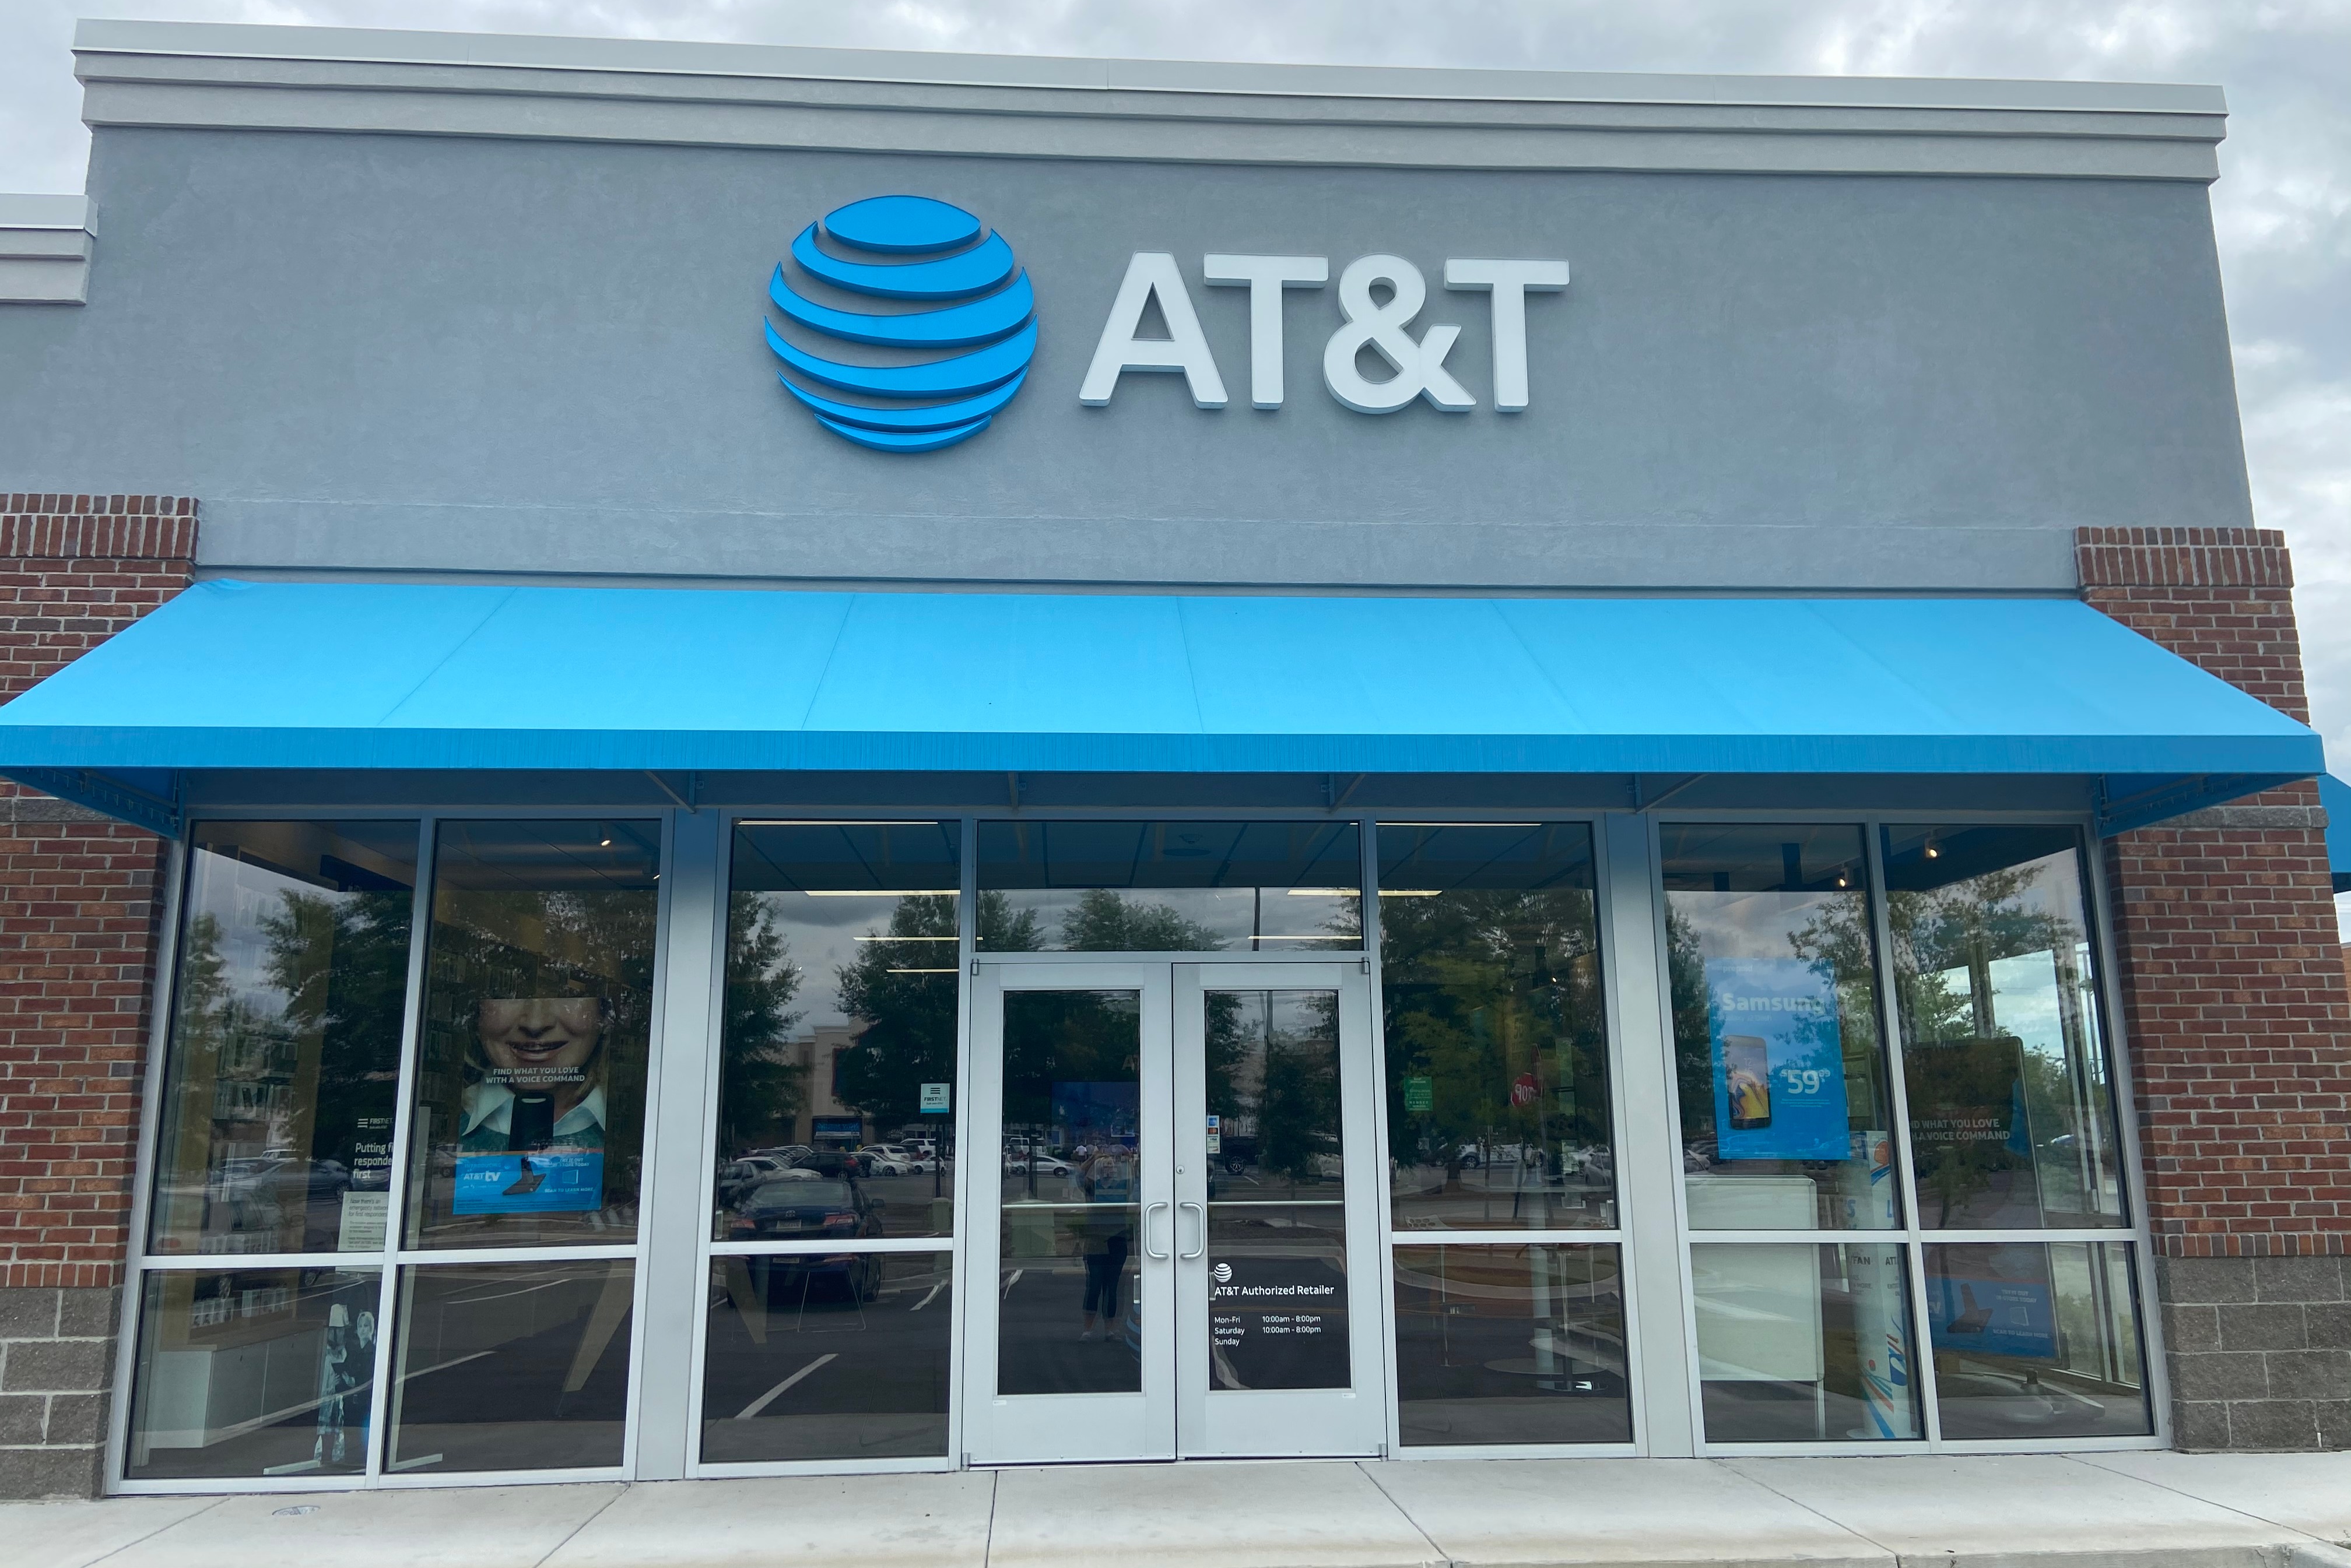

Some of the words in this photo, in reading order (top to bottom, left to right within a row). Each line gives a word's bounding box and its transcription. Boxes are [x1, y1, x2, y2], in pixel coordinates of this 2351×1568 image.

[1079, 250, 1570, 415] AT&T
[1722, 992, 1826, 1015] Samsung
[1921, 1119, 1948, 1129] WHAT
[1950, 1119, 1970, 1128] YOU
[1972, 1118, 2000, 1128] LOVE
[1926, 1131, 1955, 1141] VOICE
[1956, 1130, 2010, 1141] COMMAND
[356, 1142, 386, 1154] Putting
[353, 1169, 371, 1179] first
[1215, 1286, 1239, 1296] AT&T
[1241, 1285, 1295, 1296] Authorized
[1297, 1285, 1334, 1295] Retailer
[1215, 1316, 1240, 1324] Mon-Fri
[1296, 1315, 1321, 1323] 8:00pm
[1215, 1327, 1245, 1335] Saturday
[1296, 1326, 1321, 1334] 8:00pm
[1215, 1338, 1240, 1346] Sunday
